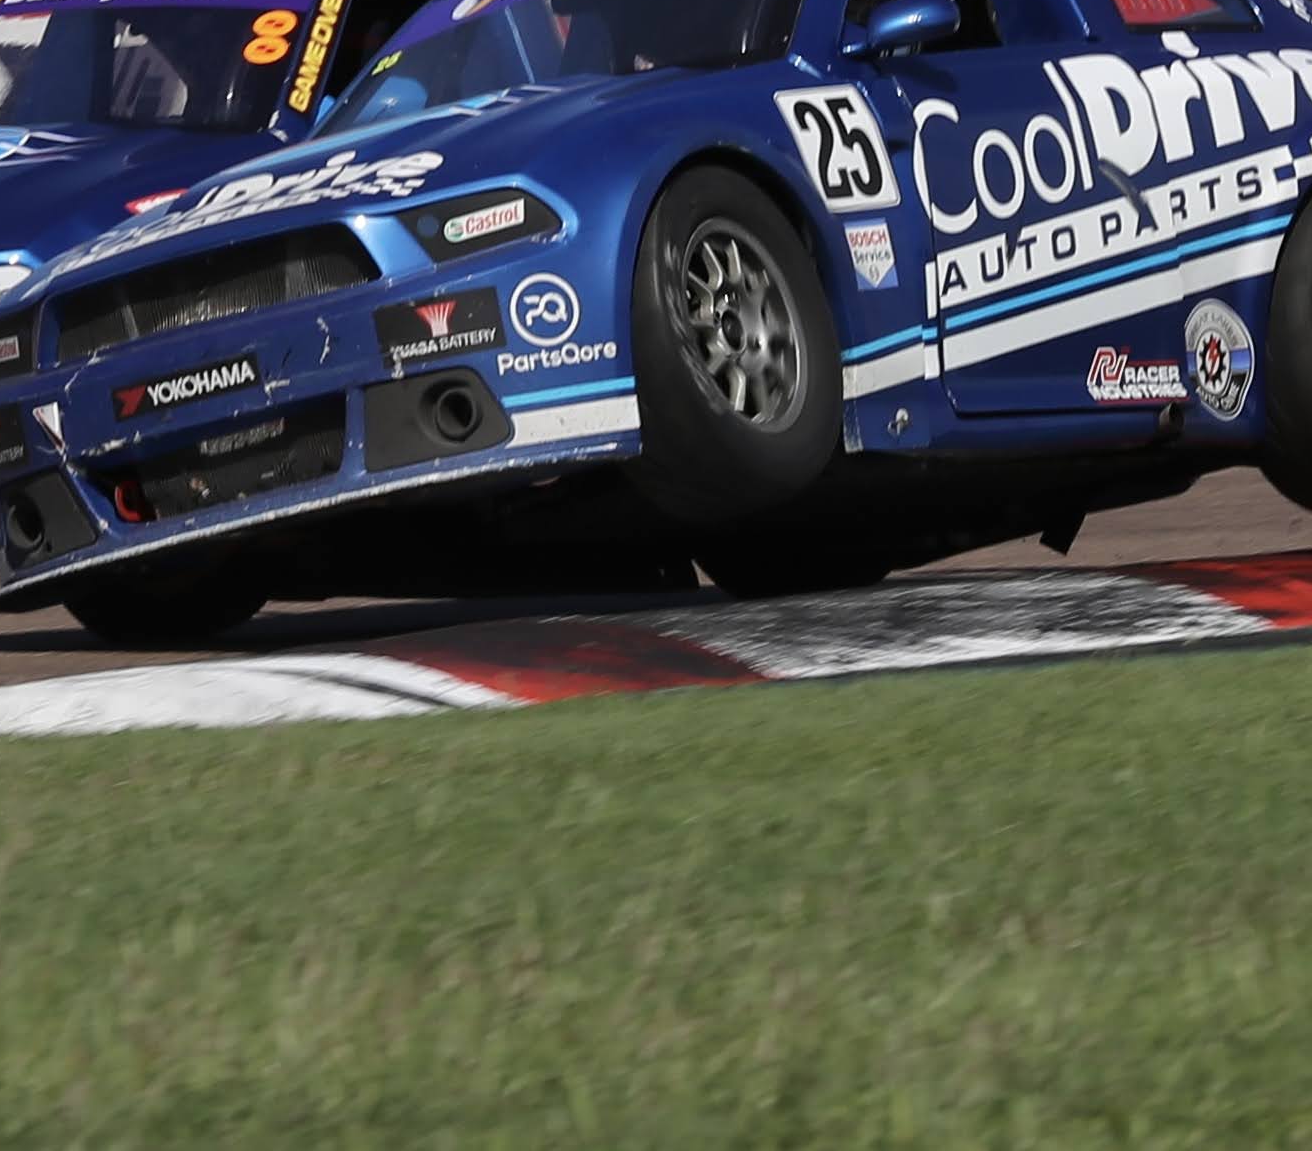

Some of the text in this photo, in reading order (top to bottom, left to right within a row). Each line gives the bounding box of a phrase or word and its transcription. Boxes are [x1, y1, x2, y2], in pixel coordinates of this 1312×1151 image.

[794, 96, 883, 199] 25
[465, 203, 519, 234] Castrol
[940, 165, 1263, 297] AUTO PARTS
[849, 230, 887, 247] BOSCH
[853, 249, 891, 264] Service
[439, 328, 496, 352] BATTERY
[147, 360, 255, 406] YOKOHAMA
[1124, 365, 1180, 383] RACER
